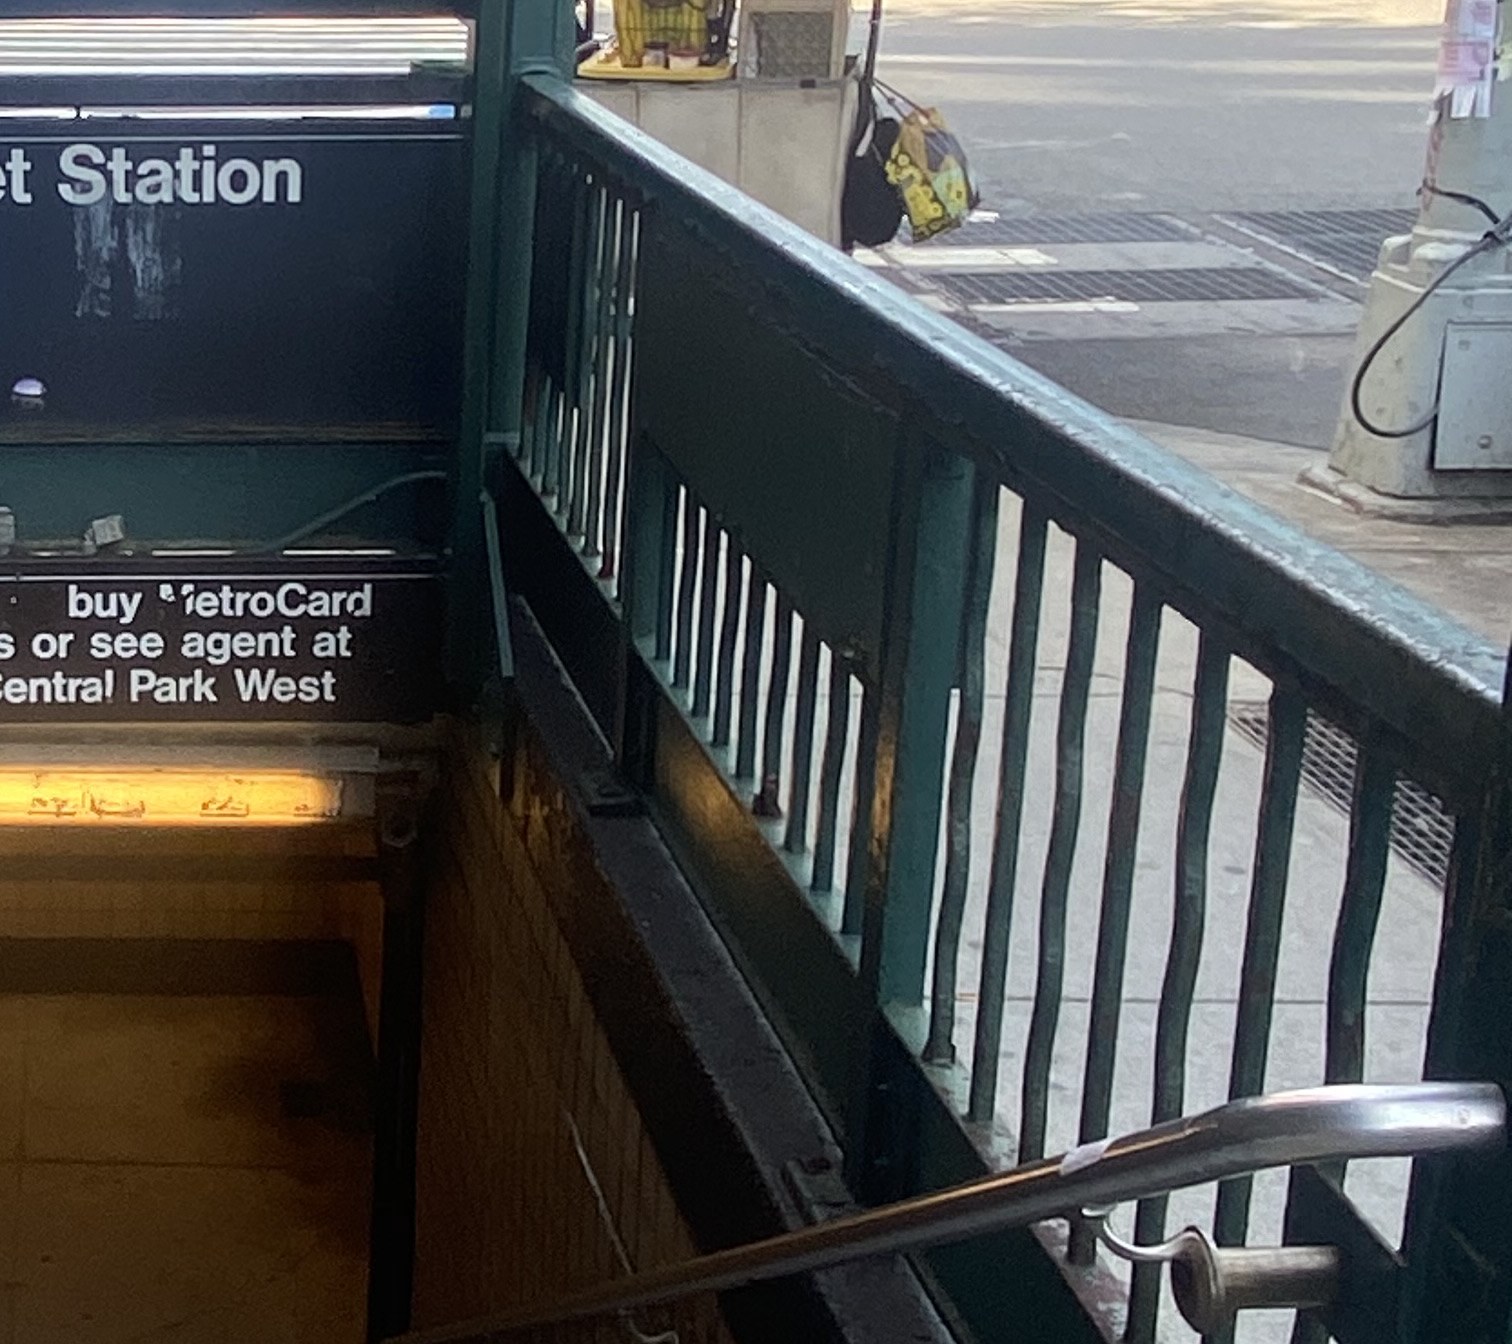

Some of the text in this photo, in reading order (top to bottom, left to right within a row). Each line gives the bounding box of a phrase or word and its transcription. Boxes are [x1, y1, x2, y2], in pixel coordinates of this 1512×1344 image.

[57, 143, 302, 205] Station
[68, 584, 143, 624] buy
[31, 632, 75, 660] or
[89, 632, 165, 659] see
[180, 625, 297, 666] agent
[312, 625, 353, 658] at
[129, 668, 218, 703] Park
[234, 668, 337, 702] West
